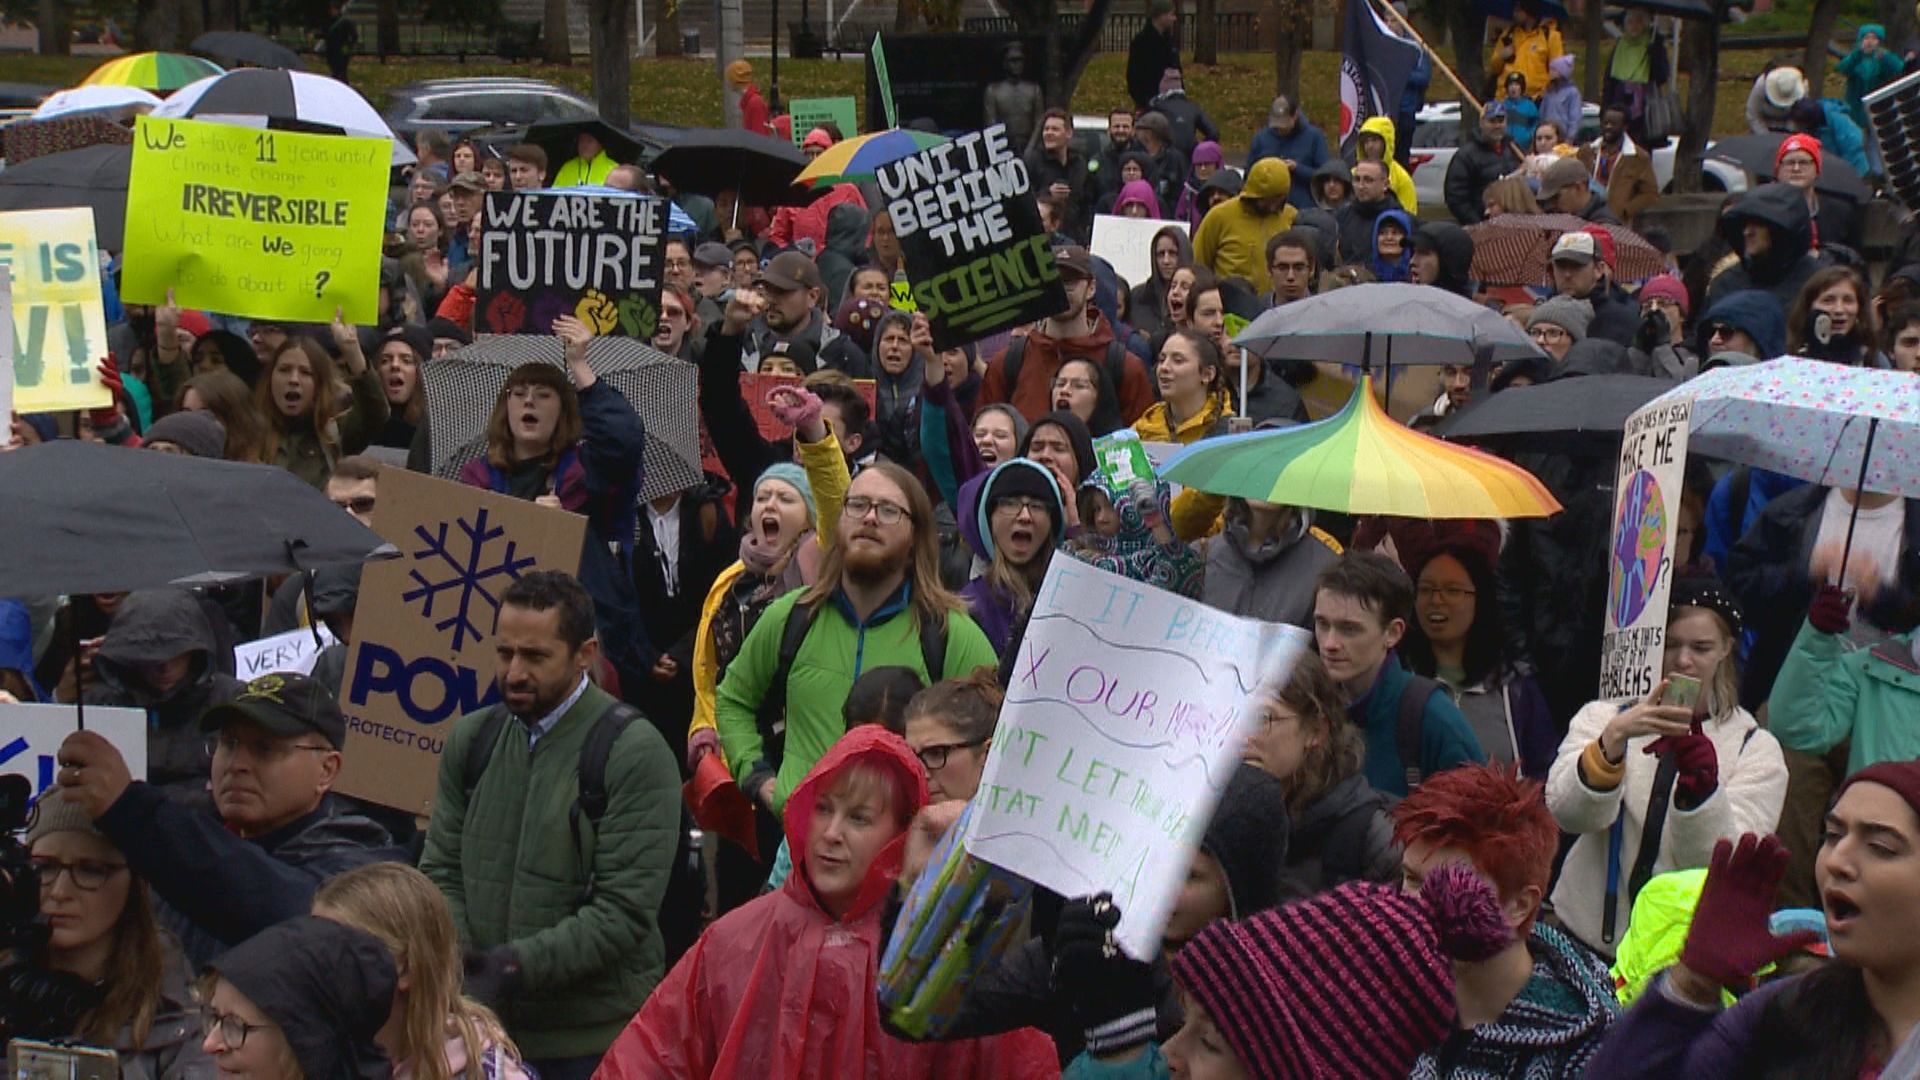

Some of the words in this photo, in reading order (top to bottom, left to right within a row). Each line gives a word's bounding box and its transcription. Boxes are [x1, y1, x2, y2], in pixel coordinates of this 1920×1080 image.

[142, 122, 187, 151] We
[255, 132, 277, 164] 11
[877, 123, 1014, 199] UNITE
[182, 183, 349, 227] IRREVERSIBLE
[486, 194, 540, 229] WE
[548, 196, 605, 230] ARE
[609, 198, 664, 235] THE
[887, 158, 1030, 239] BEHIND
[154, 217, 212, 246] What
[302, 244, 343, 267] going
[929, 204, 1013, 257] THE
[39, 242, 86, 283] IS
[211, 270, 229, 287] do
[238, 272, 286, 293] about
[482, 230, 658, 291] FUTURE
[913, 234, 1061, 321] SCIENCE
[1652, 426, 1677, 467] ME
[1091, 581, 1145, 629] IT
[244, 640, 303, 675] VERY
[1066, 665, 1157, 728] OUR
[1601, 665, 1653, 699] PROBLEMS
[1056, 747, 1129, 799] LET
